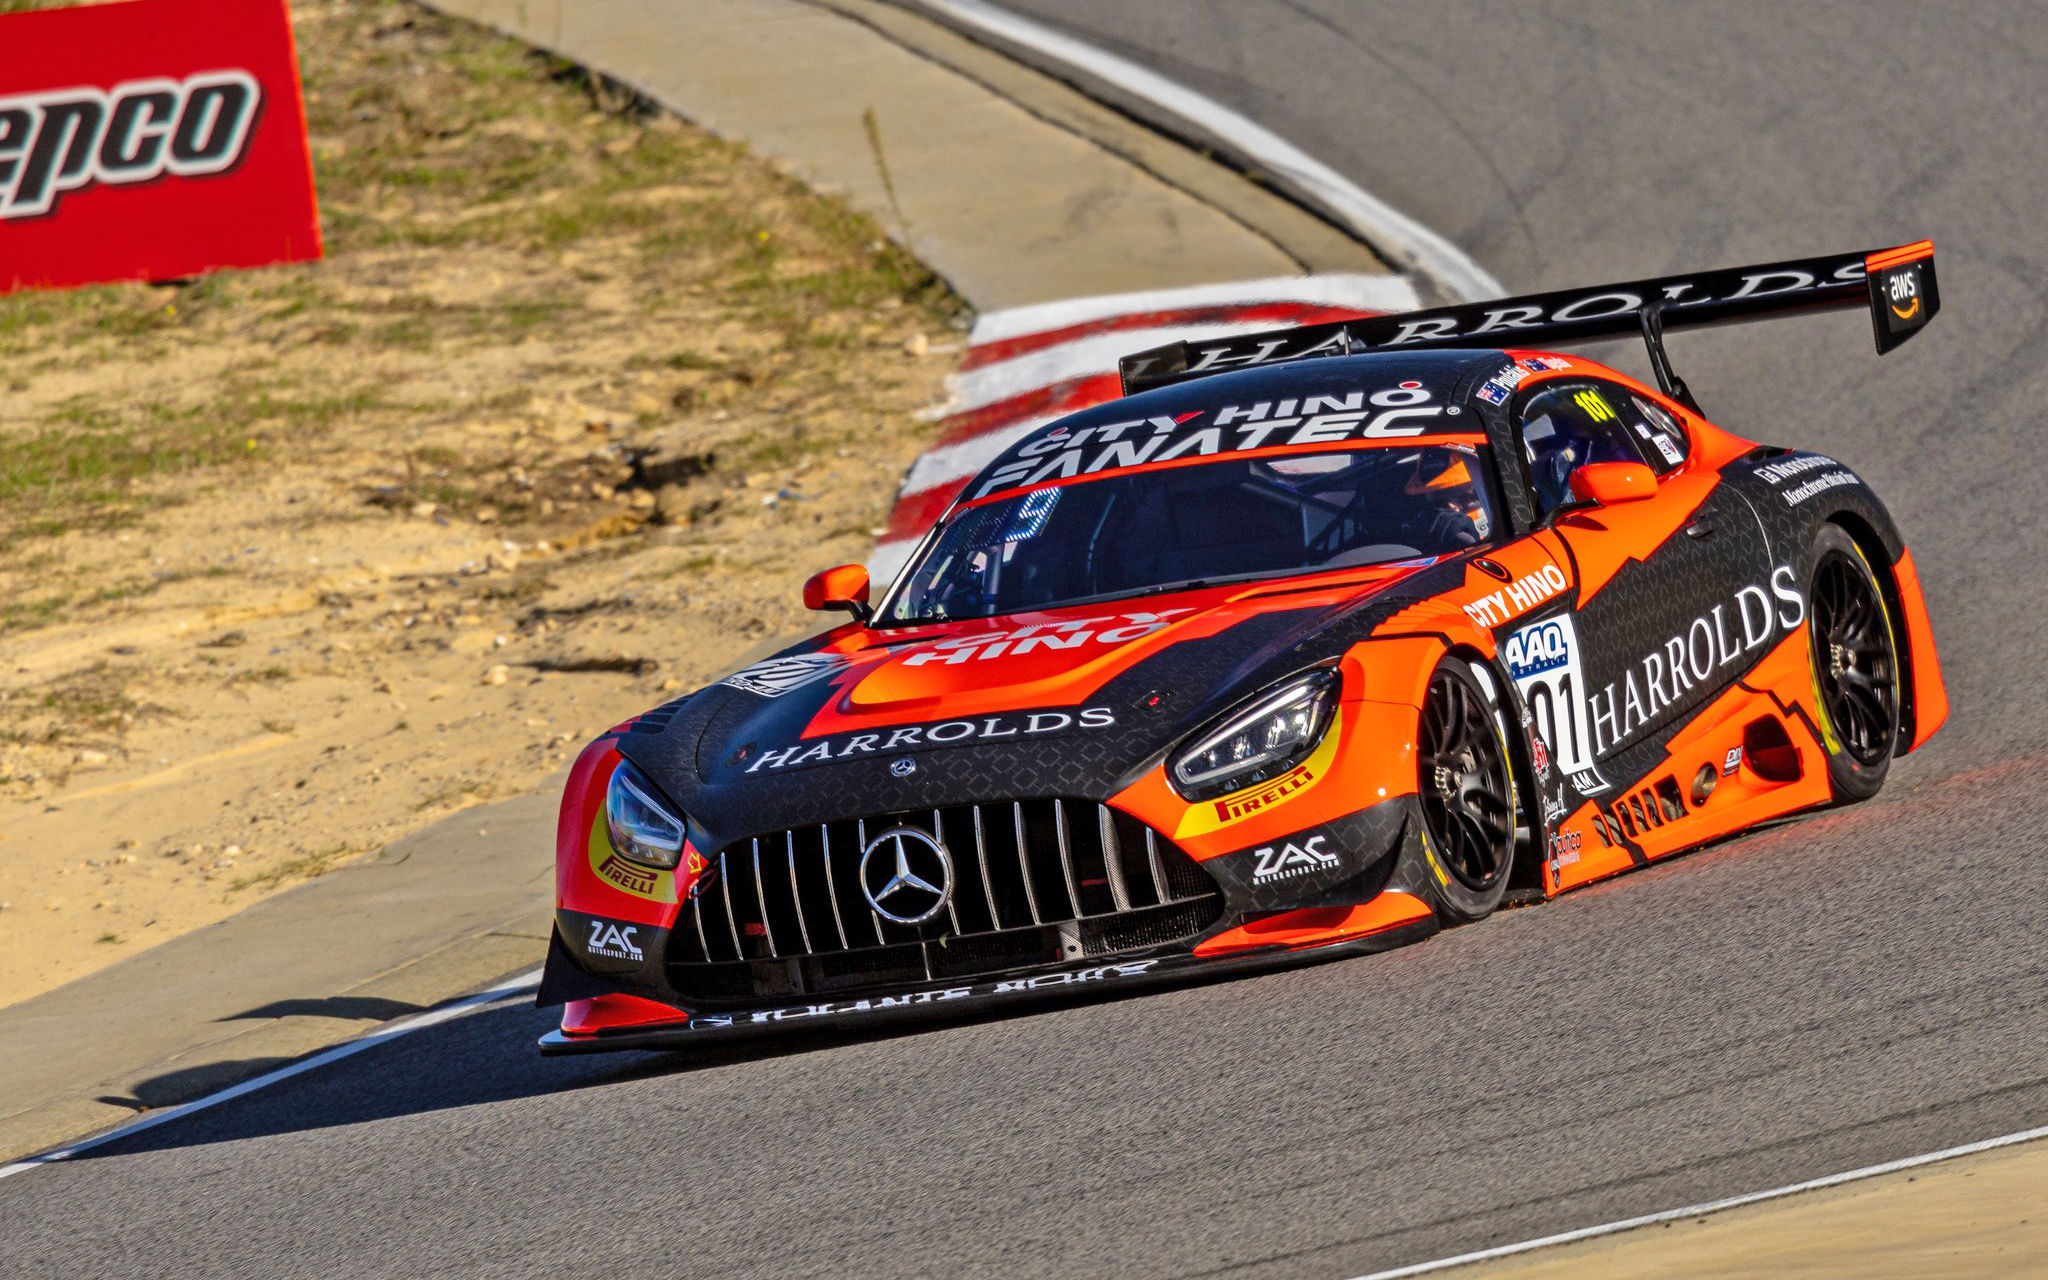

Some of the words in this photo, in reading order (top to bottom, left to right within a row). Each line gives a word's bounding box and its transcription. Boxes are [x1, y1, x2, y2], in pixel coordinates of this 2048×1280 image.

[1889, 271, 1916, 301] aws
[1018, 411, 1204, 460] CITY
[1215, 381, 1431, 426] HINO
[1573, 389, 1615, 423] 101
[1463, 590, 1511, 628] CITY
[1509, 564, 1567, 612] HINO
[901, 622, 1171, 666] HINO
[934, 607, 1197, 650] CITY
[1588, 566, 1805, 756] HARROLDS
[744, 707, 1116, 774] HARROLDS
[1214, 765, 1314, 823] PIRELLI
[598, 854, 659, 895] PIRELLI
[1252, 858, 1340, 886] MOTORSPORT.COM
[1253, 835, 1337, 878] ZAC
[588, 920, 642, 954] ZAC
